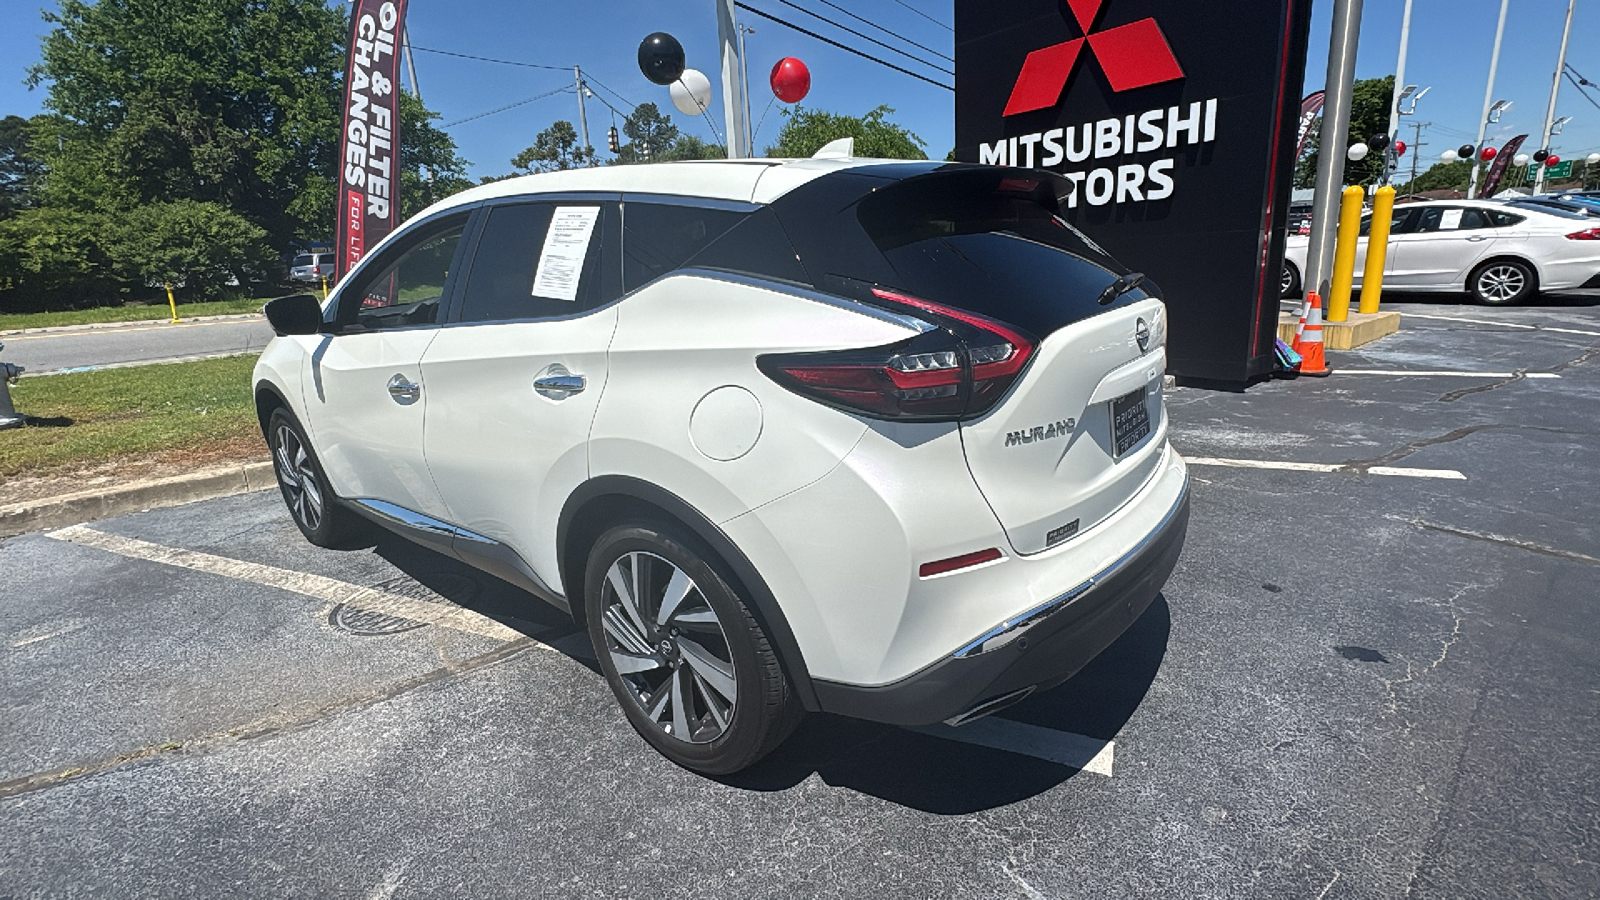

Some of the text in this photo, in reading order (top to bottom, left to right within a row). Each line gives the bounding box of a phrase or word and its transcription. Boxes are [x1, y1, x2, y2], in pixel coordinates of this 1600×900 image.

[345, 14, 375, 187] CHANGES
[367, 1, 397, 219] OIL & FILTER
[979, 98, 1217, 169] MITSUBISHI
[351, 196, 361, 231] FOR
[1062, 158, 1174, 209] TORS
[1004, 417, 1076, 447] MURANO
